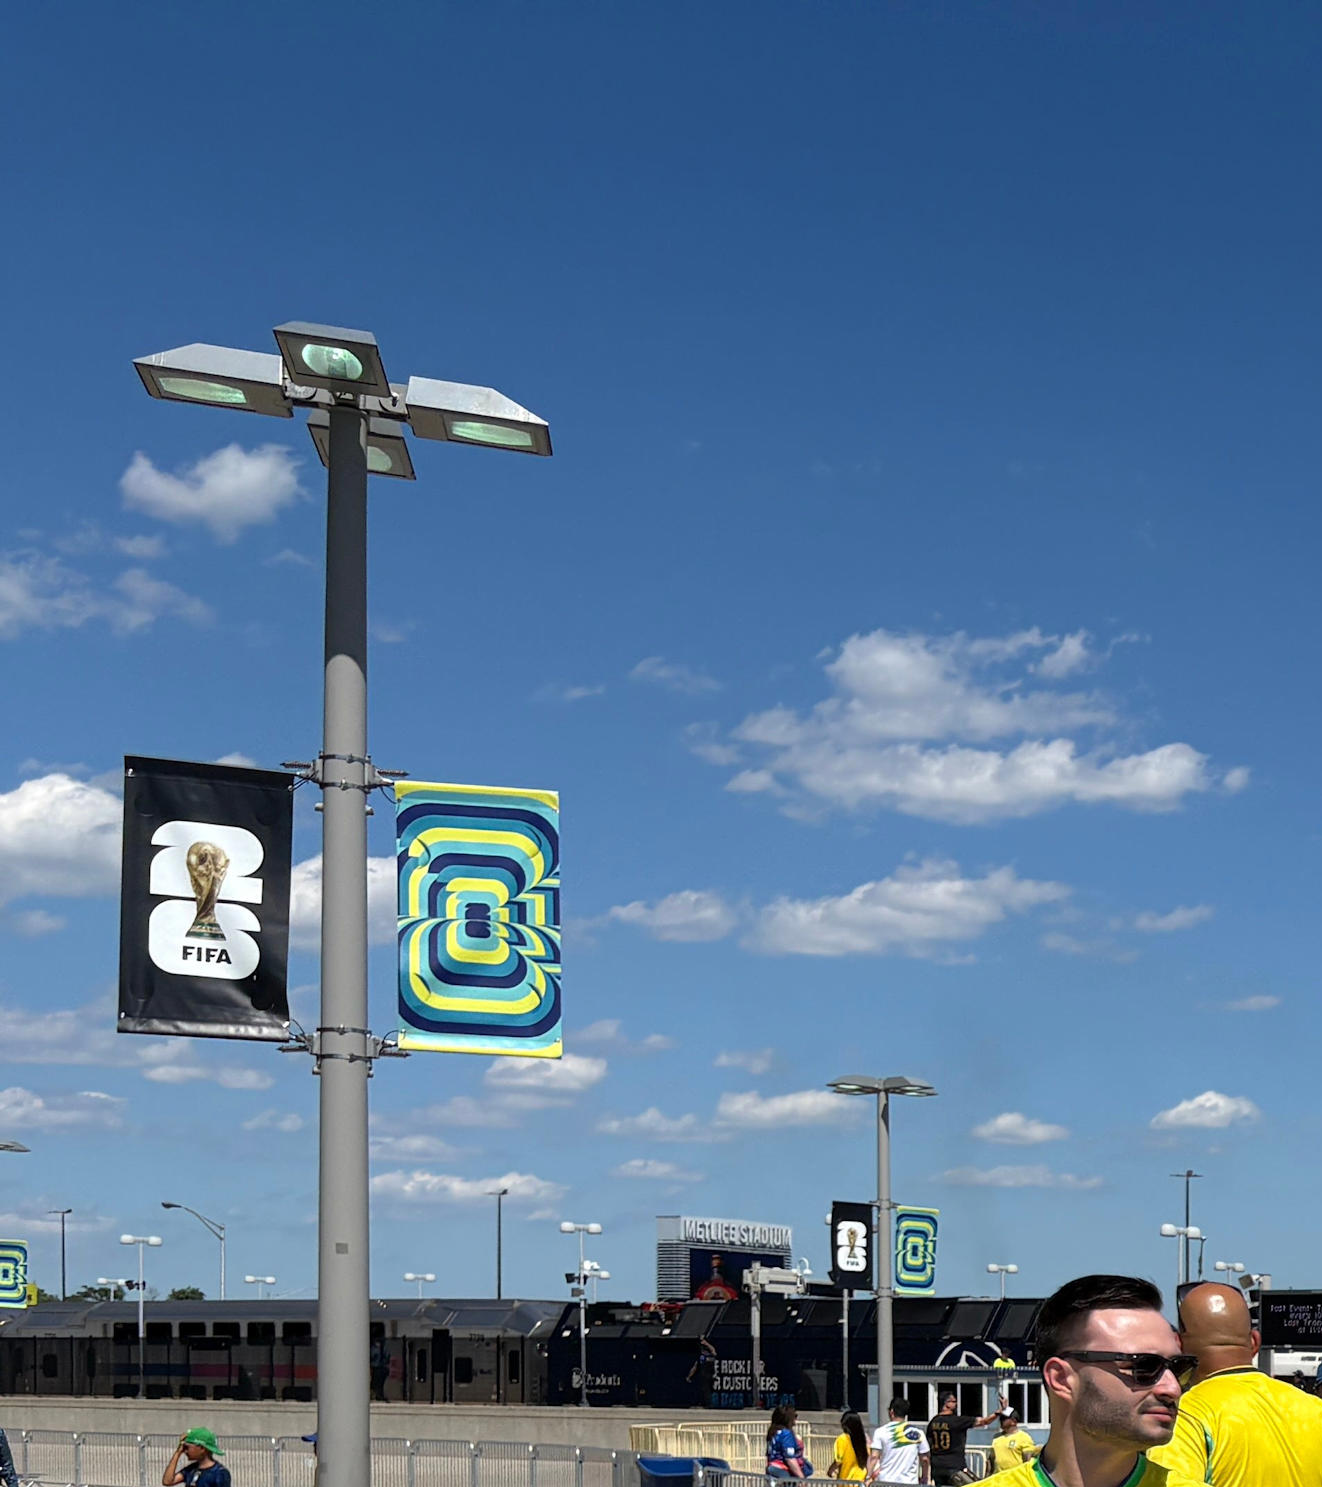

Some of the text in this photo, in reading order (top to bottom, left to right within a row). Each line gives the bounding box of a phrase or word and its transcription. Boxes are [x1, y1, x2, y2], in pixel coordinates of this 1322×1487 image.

[182, 945, 232, 964] FIFA
[685, 1219, 792, 1249] METLIFE STADIUM
[747, 1359, 766, 1375] FR
[722, 1376, 779, 1391] CUSTOERS
[932, 1431, 950, 1449] 10
